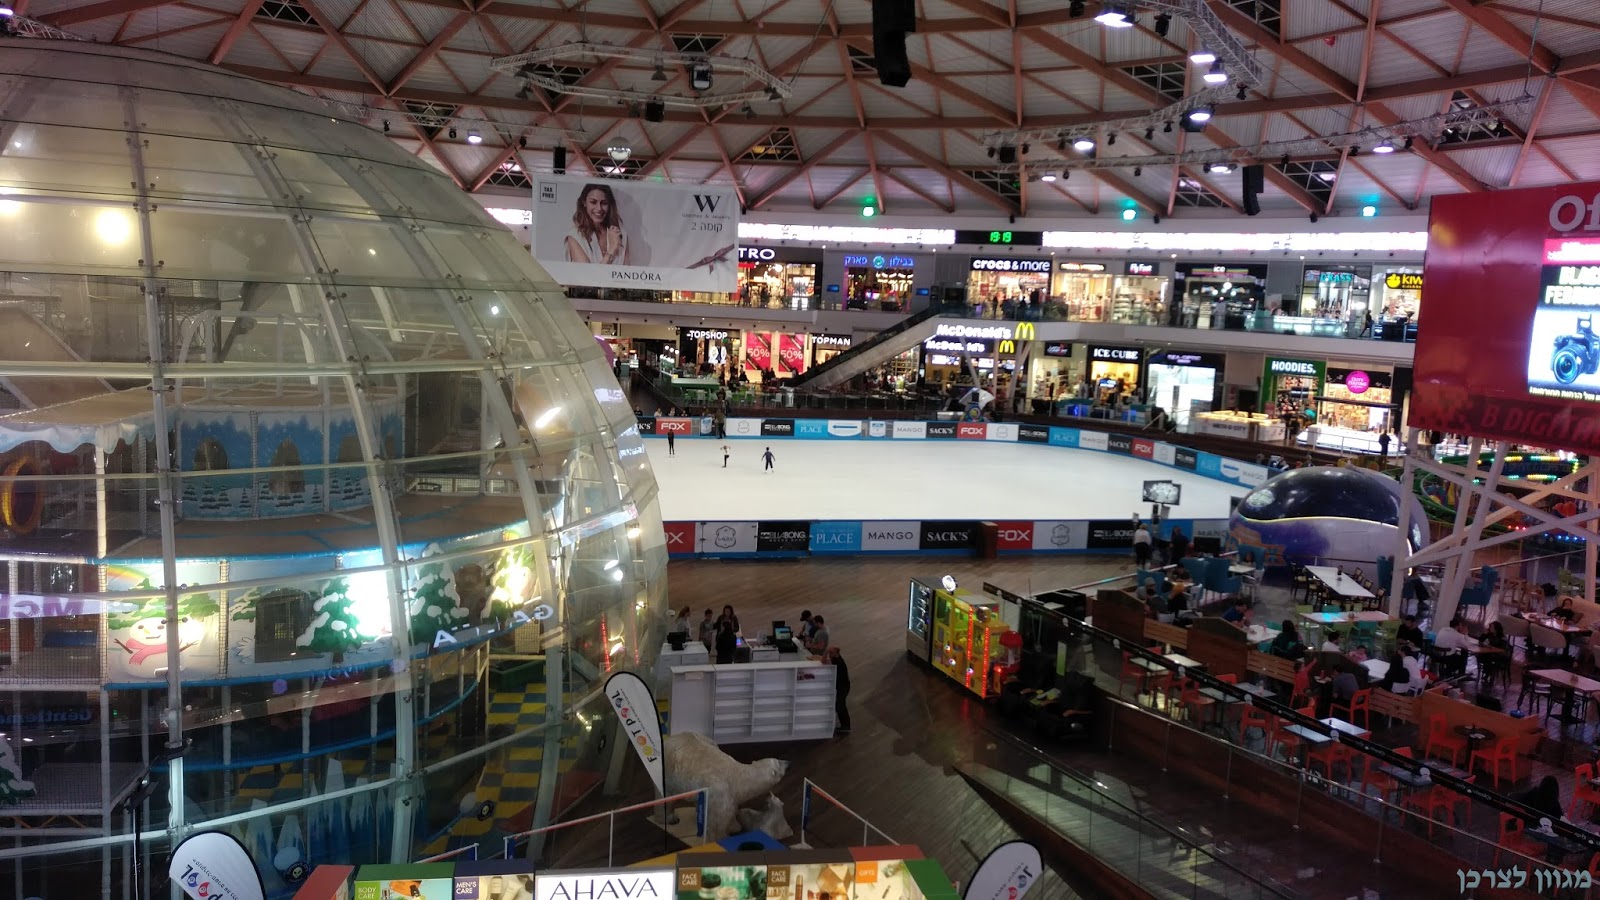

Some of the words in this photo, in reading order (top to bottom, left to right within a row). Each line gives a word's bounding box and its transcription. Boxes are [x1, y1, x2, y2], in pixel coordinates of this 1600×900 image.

[693, 194, 721, 213] W
[691, 221, 697, 230] 2
[700, 222, 723, 233] קומה
[989, 231, 1013, 243] 19:19
[844, 255, 868, 266] פארק
[972, 260, 1011, 271] crocs
[1020, 260, 1051, 271] more
[936, 324, 1011, 339] McDonald's
[747, 348, 770, 358] 50%
[780, 350, 803, 360] 50%
[1093, 348, 1110, 358] ICE
[1111, 349, 1138, 360] CUBE
[660, 422, 686, 431] FOX
[961, 427, 983, 435] FOX
[1134, 443, 1152, 454] FOX
[816, 533, 854, 544] PLACE
[868, 531, 914, 540] MANGO
[926, 531, 969, 542] SACK'S
[456, 887, 473, 895] CARE
[549, 876, 658, 900] AHAVA
